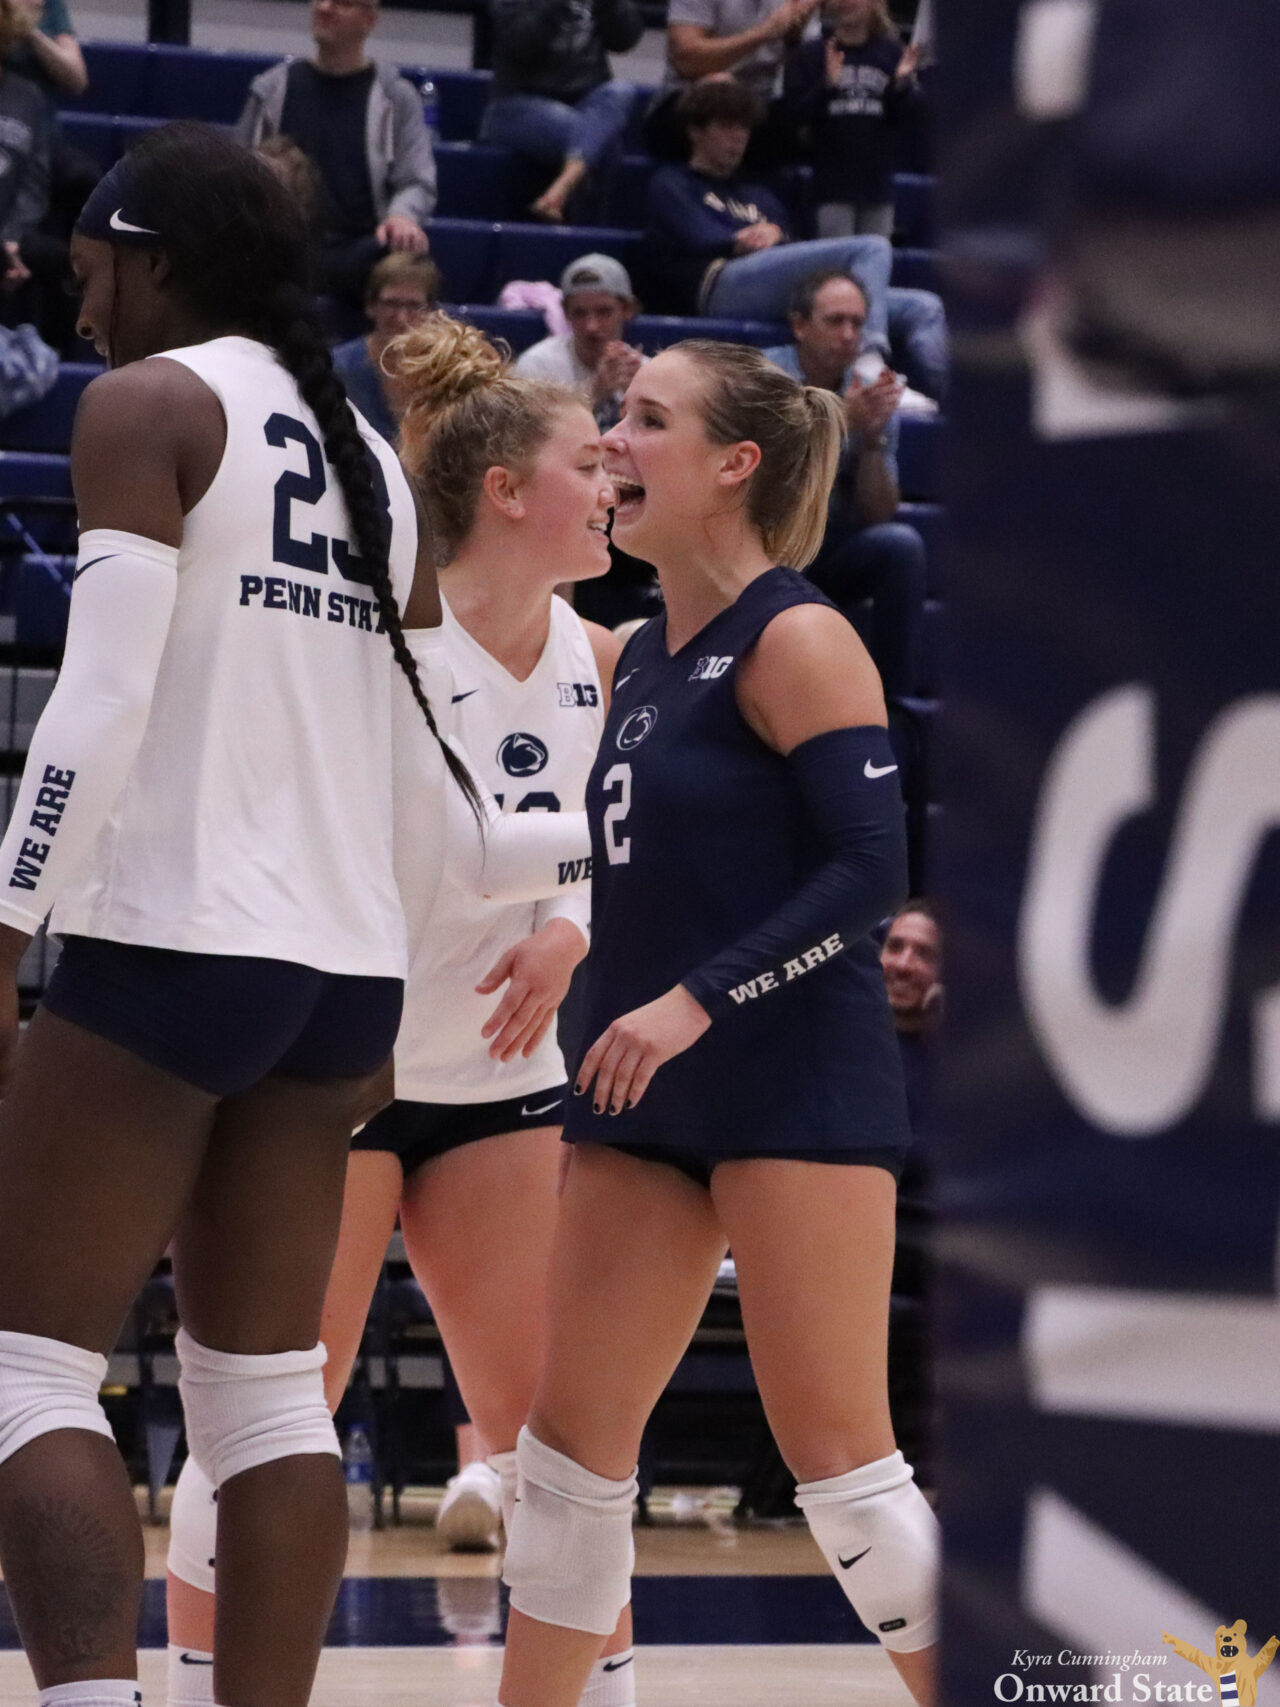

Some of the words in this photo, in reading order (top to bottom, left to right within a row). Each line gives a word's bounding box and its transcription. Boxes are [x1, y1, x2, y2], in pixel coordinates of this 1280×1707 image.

[239, 574, 322, 619] PENN
[327, 591, 388, 635] STAT
[29, 764, 76, 837] ARE
[602, 762, 633, 866] 2
[8, 837, 51, 892] WE
[727, 971, 780, 1004] WE
[782, 932, 844, 981] ARE
